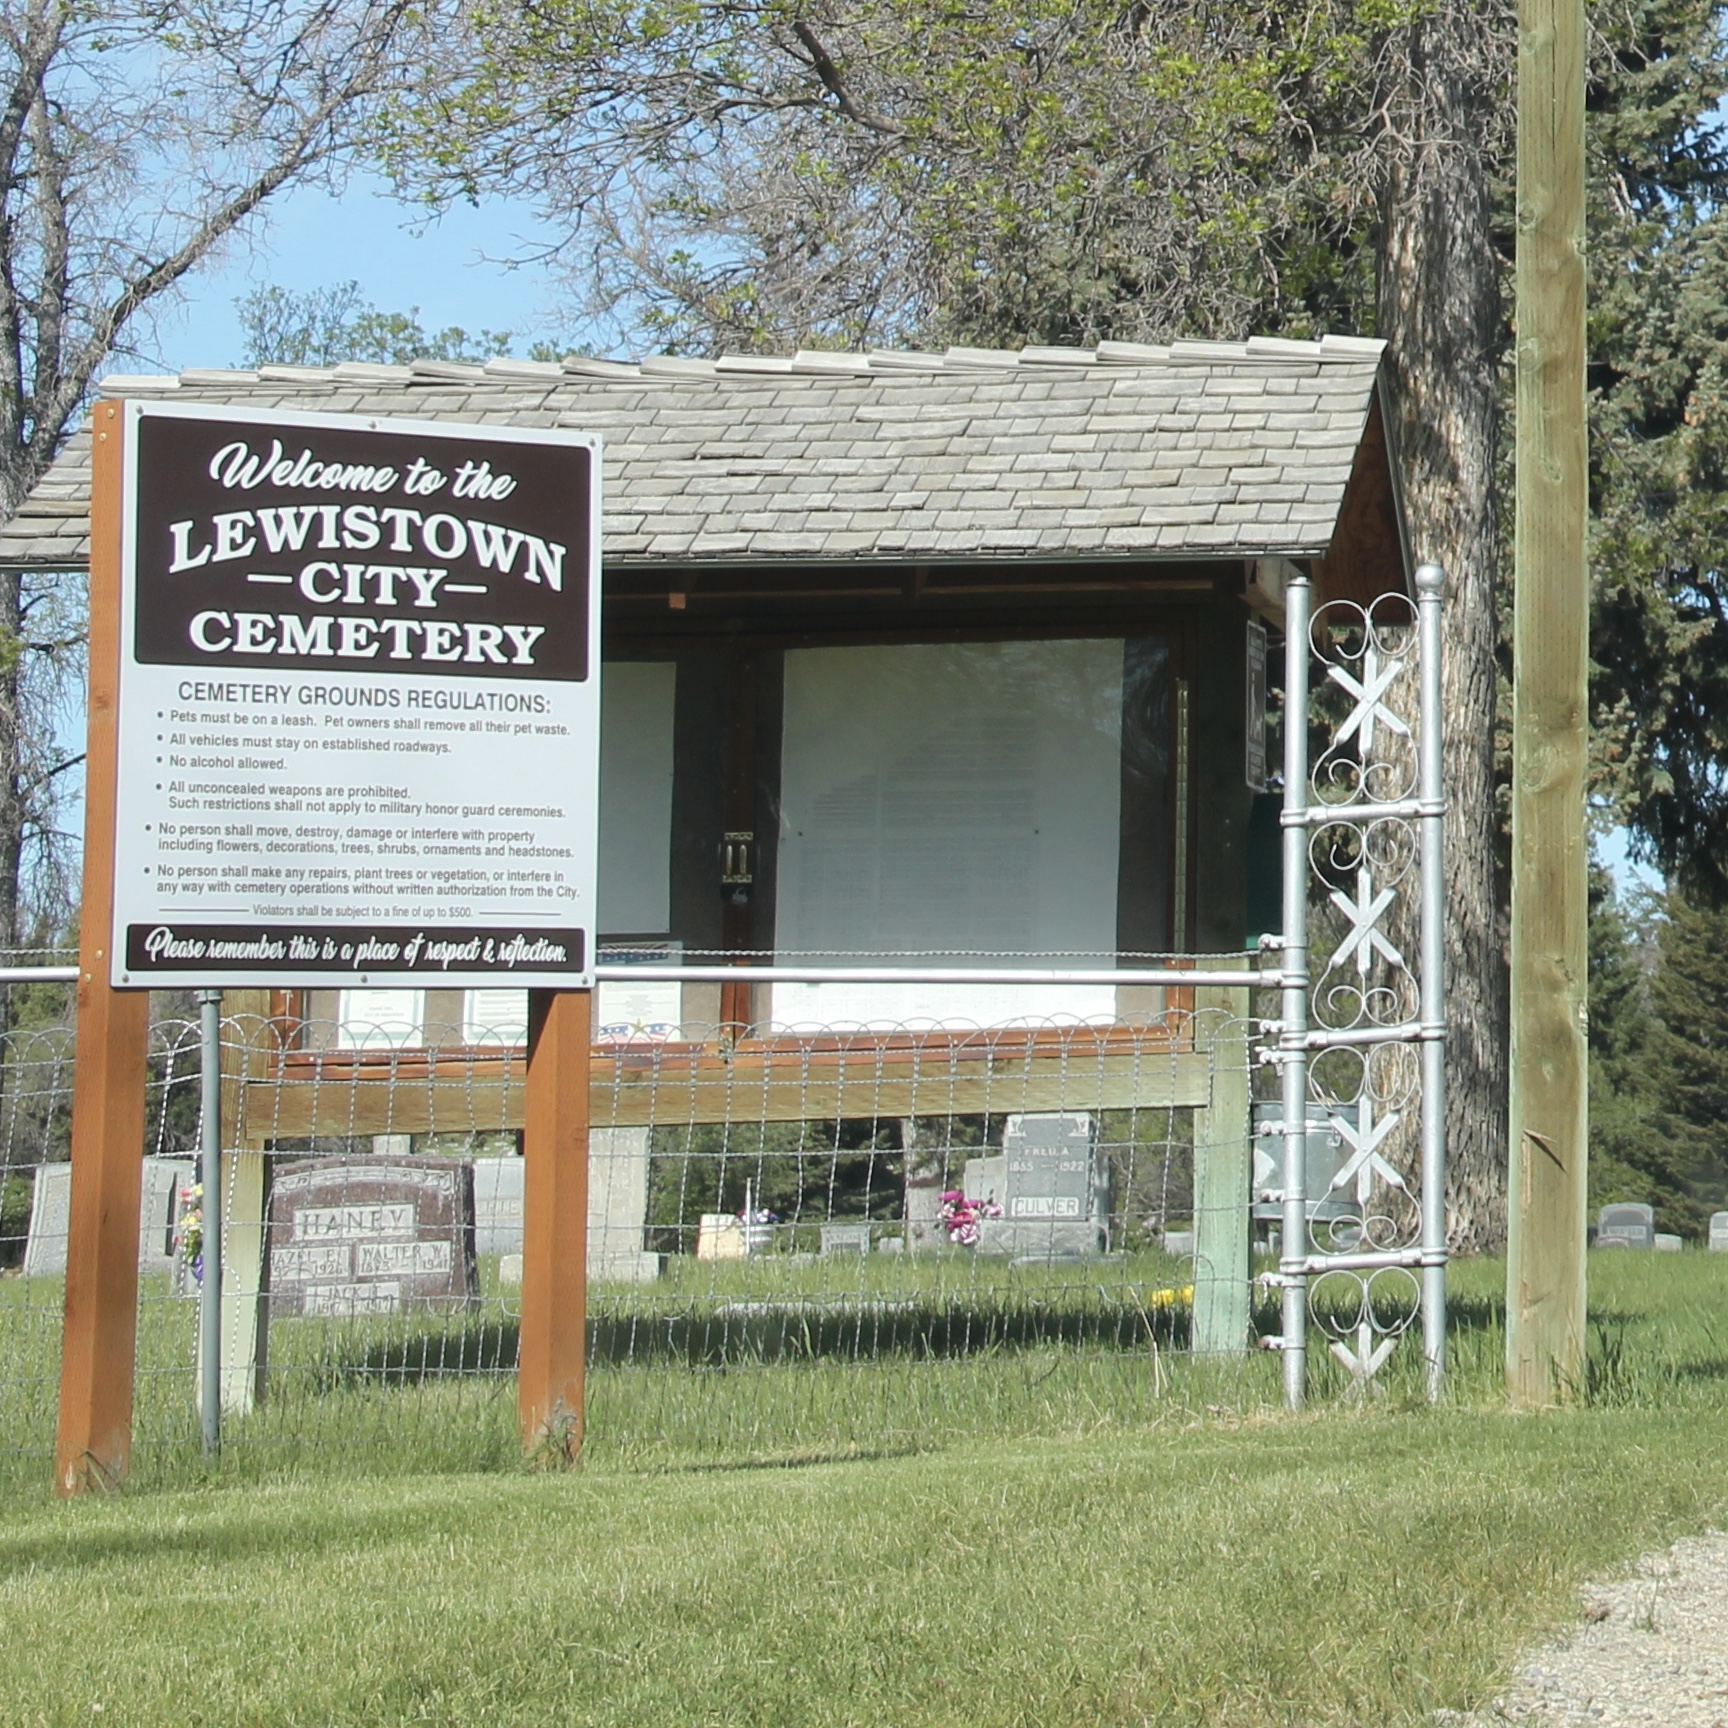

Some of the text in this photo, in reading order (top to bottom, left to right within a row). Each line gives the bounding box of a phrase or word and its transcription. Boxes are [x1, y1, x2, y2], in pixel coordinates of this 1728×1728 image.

[210, 439, 517, 500] Welcome to the
[169, 504, 567, 592] LEWISTOWN
[300, 562, 449, 608] CITY
[189, 611, 546, 665] CEMETERY
[178, 682, 550, 713] CEMETERY GROUNDS REGULATIONS:
[170, 710, 570, 736] Pets must be on a leash. Pet owners shall remove all their pet waste.
[169, 733, 452, 755] All vehicles must stay on established roadways.
[169, 754, 287, 769] No alcohol allowed.
[168, 781, 412, 800] All unconcealed weapons are prohibited.
[168, 796, 565, 818] Such restrictions shall not apply to military honor guard ceremonies.
[158, 822, 535, 844] No person shall move, destroy, damage or interfere with property
[158, 838, 574, 857] including flowers, decorations, trees, shrubs, ornaments and headstones.
[157, 864, 564, 883] No person shall make any repairs, plant trees or vegetation, or interfere in
[156, 880, 580, 900] any way with cemetery operations without written authorization from the City.
[253, 904, 294, 916] Violators
[296, 905, 318, 916] shall
[321, 905, 333, 916] be
[335, 906, 370, 919] subject
[371, 906, 382, 916] to
[383, 908, 390, 917] a
[392, 905, 409, 916] fine
[411, 906, 421, 916] of
[423, 908, 435, 919] up
[437, 907, 446, 917] to
[145, 926, 567, 970] Please remember this is a place of respect & reflection.
[1015, 1198, 1077, 1214] CULVER
[303, 1208, 407, 1235] HANEY
